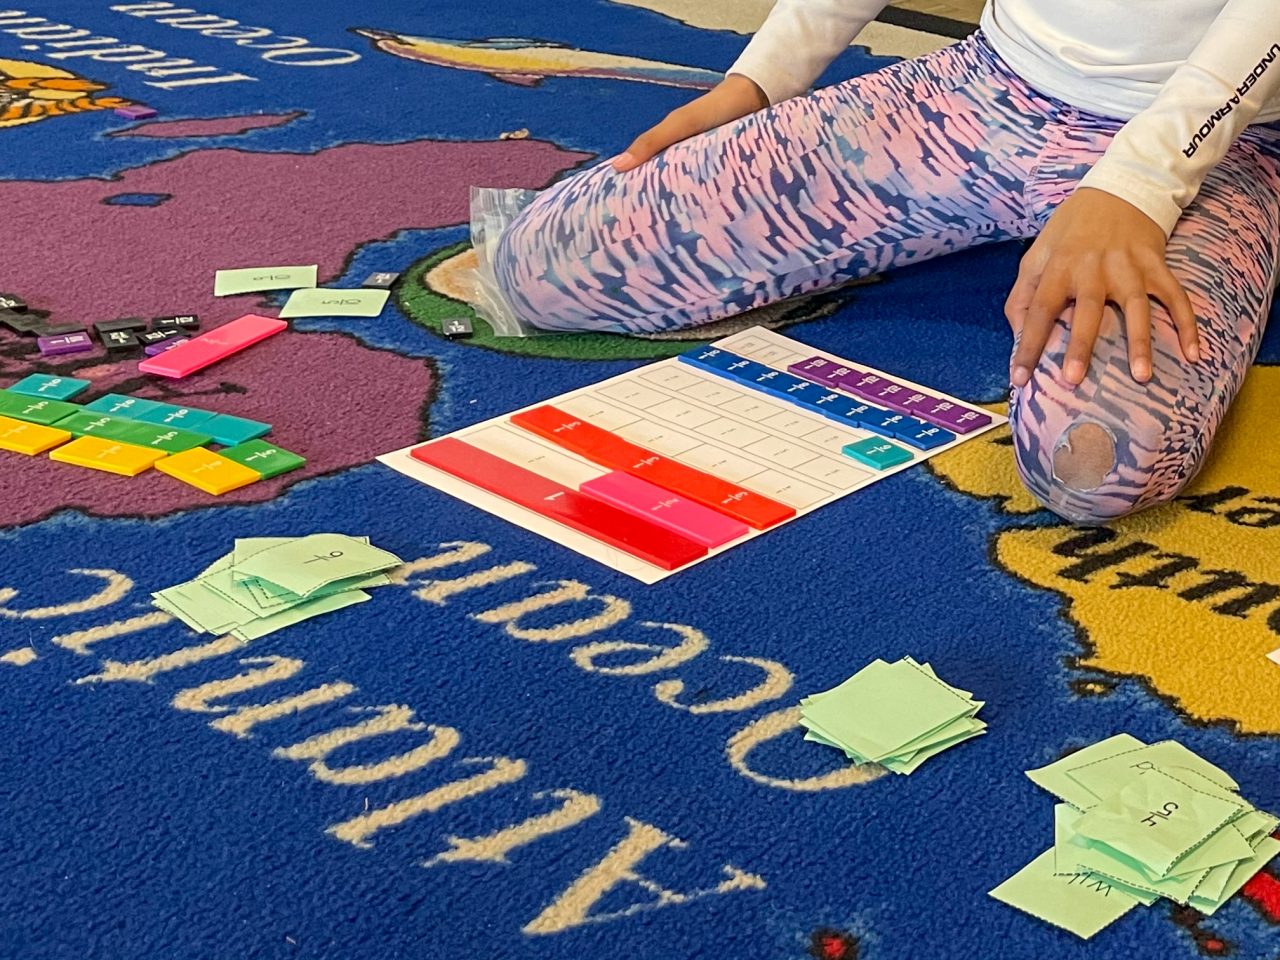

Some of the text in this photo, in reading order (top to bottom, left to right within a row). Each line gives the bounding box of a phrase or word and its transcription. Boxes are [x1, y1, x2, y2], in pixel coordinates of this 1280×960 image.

[109, 1, 363, 67] Ocean
[1182, 93, 1241, 158] ARMOUR
[0, 568, 767, 935] Atlantic
